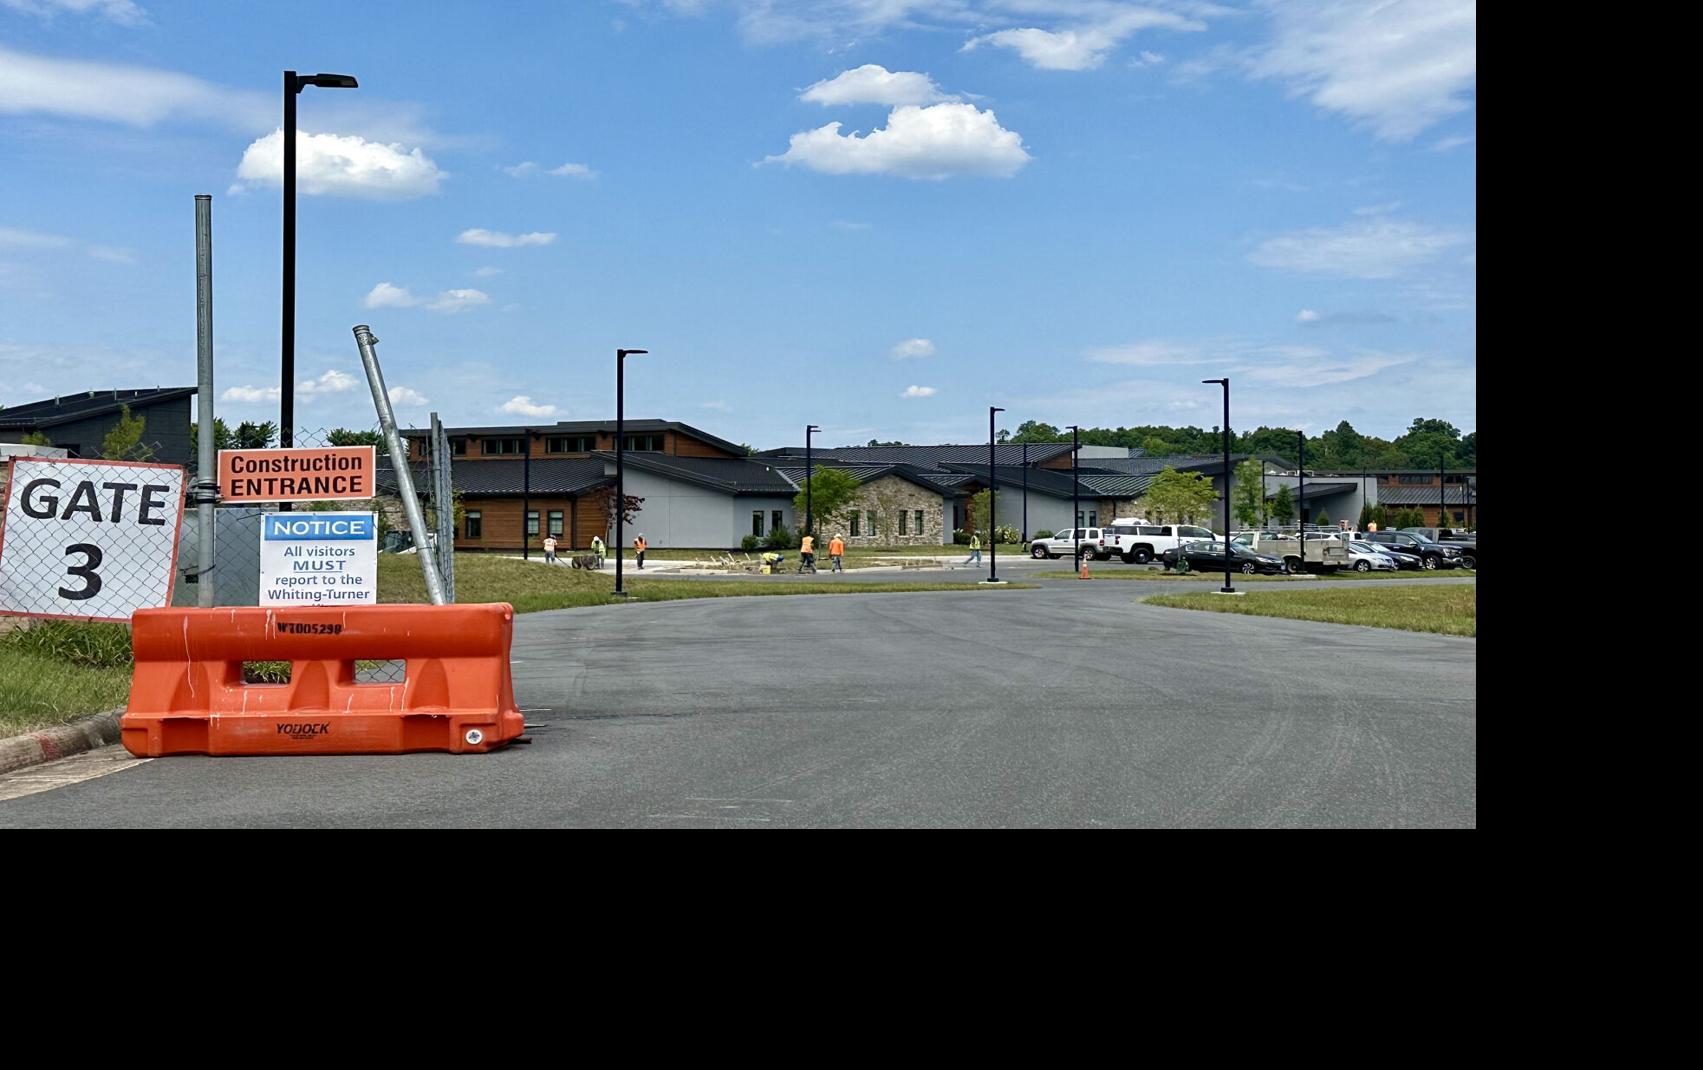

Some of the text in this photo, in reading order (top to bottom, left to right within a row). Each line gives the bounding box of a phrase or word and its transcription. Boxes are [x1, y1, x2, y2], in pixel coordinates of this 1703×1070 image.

[231, 454, 362, 474] Construction
[231, 475, 362, 497] ENTRANCE
[20, 478, 170, 526] GATE
[274, 521, 365, 535] NOTICE
[284, 546, 355, 557] All visitors
[58, 543, 103, 600] 3
[293, 560, 346, 571] MUST
[275, 574, 363, 587] report to the
[267, 589, 370, 602] Whiting-Turner
[276, 722, 331, 735] YODOCK
